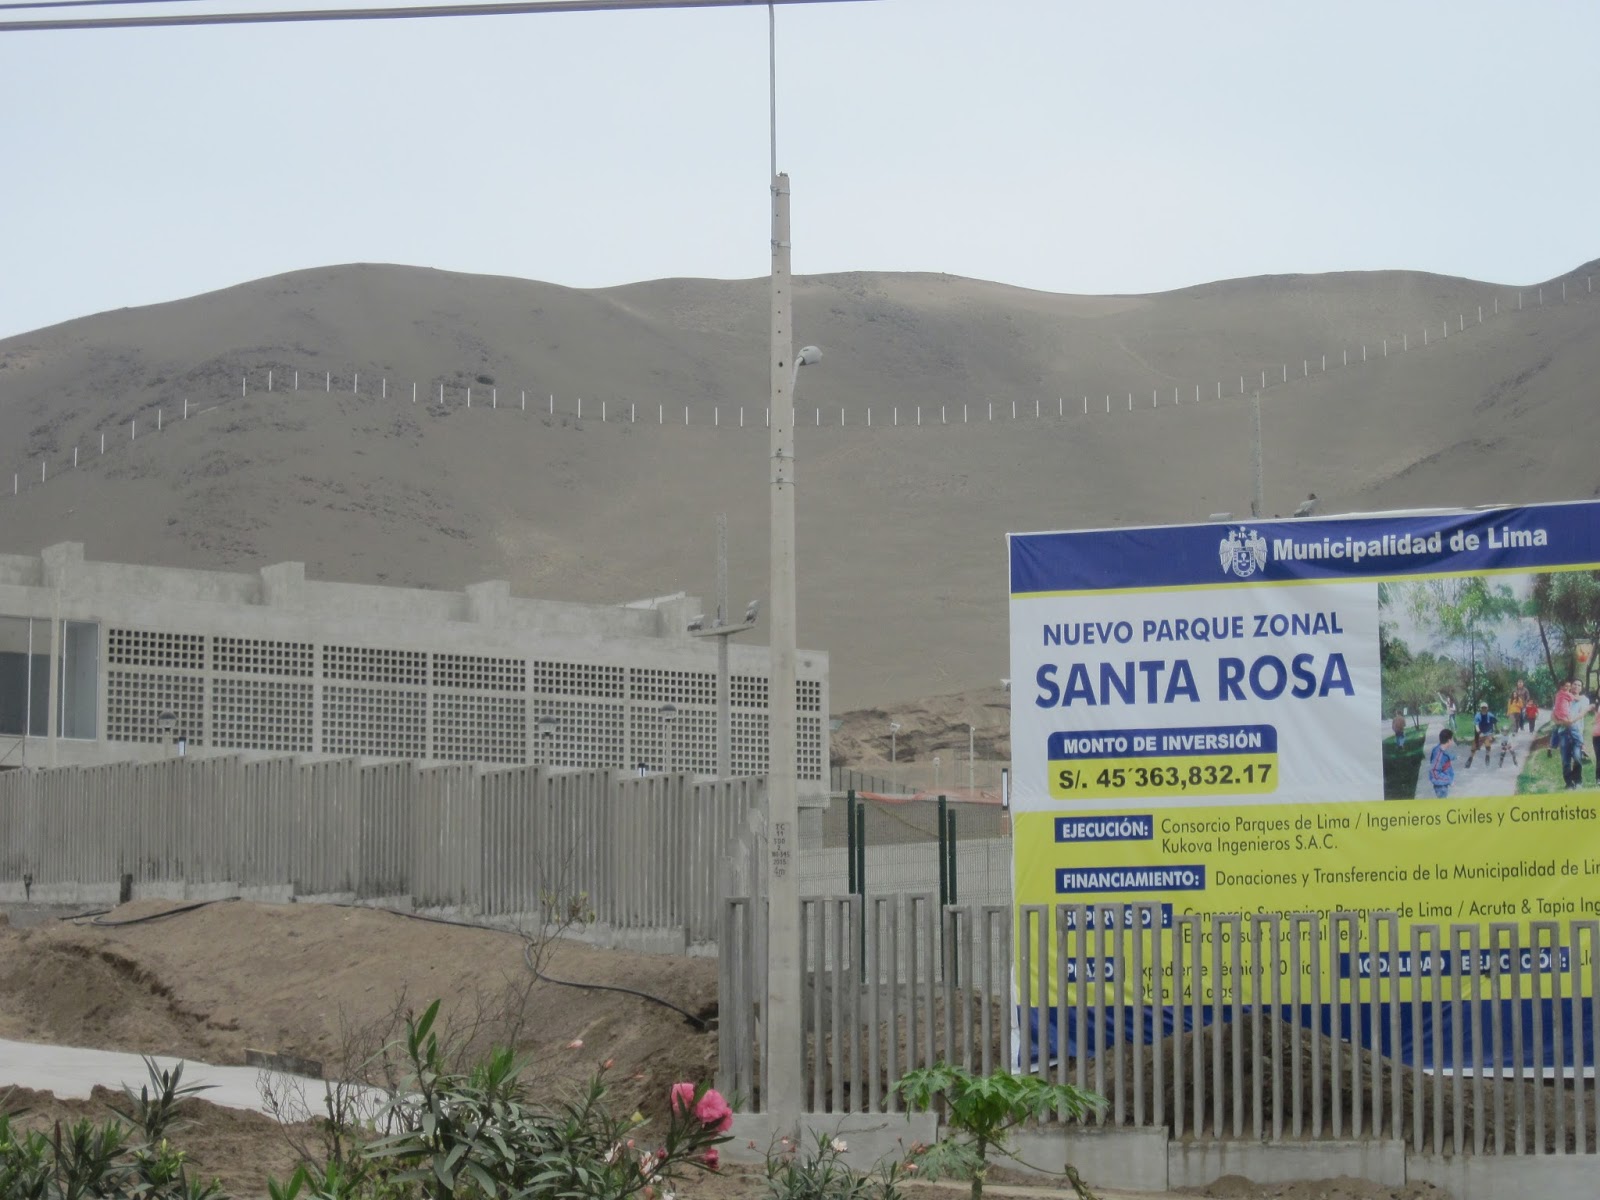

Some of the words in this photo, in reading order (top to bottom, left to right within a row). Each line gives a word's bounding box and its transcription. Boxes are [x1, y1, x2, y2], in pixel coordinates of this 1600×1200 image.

[1273, 530, 1442, 563] Municipalidad
[1450, 528, 1480, 552] de
[1488, 524, 1548, 550] Lima
[1043, 620, 1134, 646] NUEVO
[1143, 616, 1244, 643] PARQUE
[1253, 611, 1343, 638] ZONAL
[1035, 659, 1200, 709] SANTA
[1218, 652, 1355, 701] ROSA
[1063, 736, 1128, 755] MONTO
[1134, 734, 1158, 753] DE
[1162, 729, 1261, 752] INVERSIÓN
[1058, 767, 1088, 789] S/.
[1062, 818, 1149, 839] EJECUCIÓN:
[1161, 817, 1231, 834] Consorcio
[1235, 816, 1290, 835] Parques
[1295, 814, 1312, 830] de
[1317, 813, 1350, 829] Lima
[1355, 812, 1362, 829] /
[1367, 811, 1441, 831] Ingenieros
[1446, 808, 1493, 824] Civiles
[1497, 812, 1505, 827] y
[1510, 805, 1597, 823] Contratistas
[1162, 837, 1212, 854] Kukova
[1217, 835, 1290, 856] Ingenieros
[1295, 833, 1338, 850] S.A.C.
[1063, 870, 1200, 889] FINANCIAMIENTO:
[1216, 869, 1297, 887] Donaciones
[1302, 873, 1309, 888] y
[1314, 865, 1407, 883] Transferencia
[1413, 864, 1430, 880] de
[1436, 864, 1448, 880] la
[1453, 860, 1555, 882] Municipalidad
[1561, 859, 1579, 876] de
[1397, 901, 1413, 918] de
[1419, 901, 1452, 917] Lima
[1457, 900, 1464, 918] /
[1469, 900, 1516, 916] Acruta
[1521, 898, 1531, 914] &
[1536, 897, 1574, 917] Tapia
